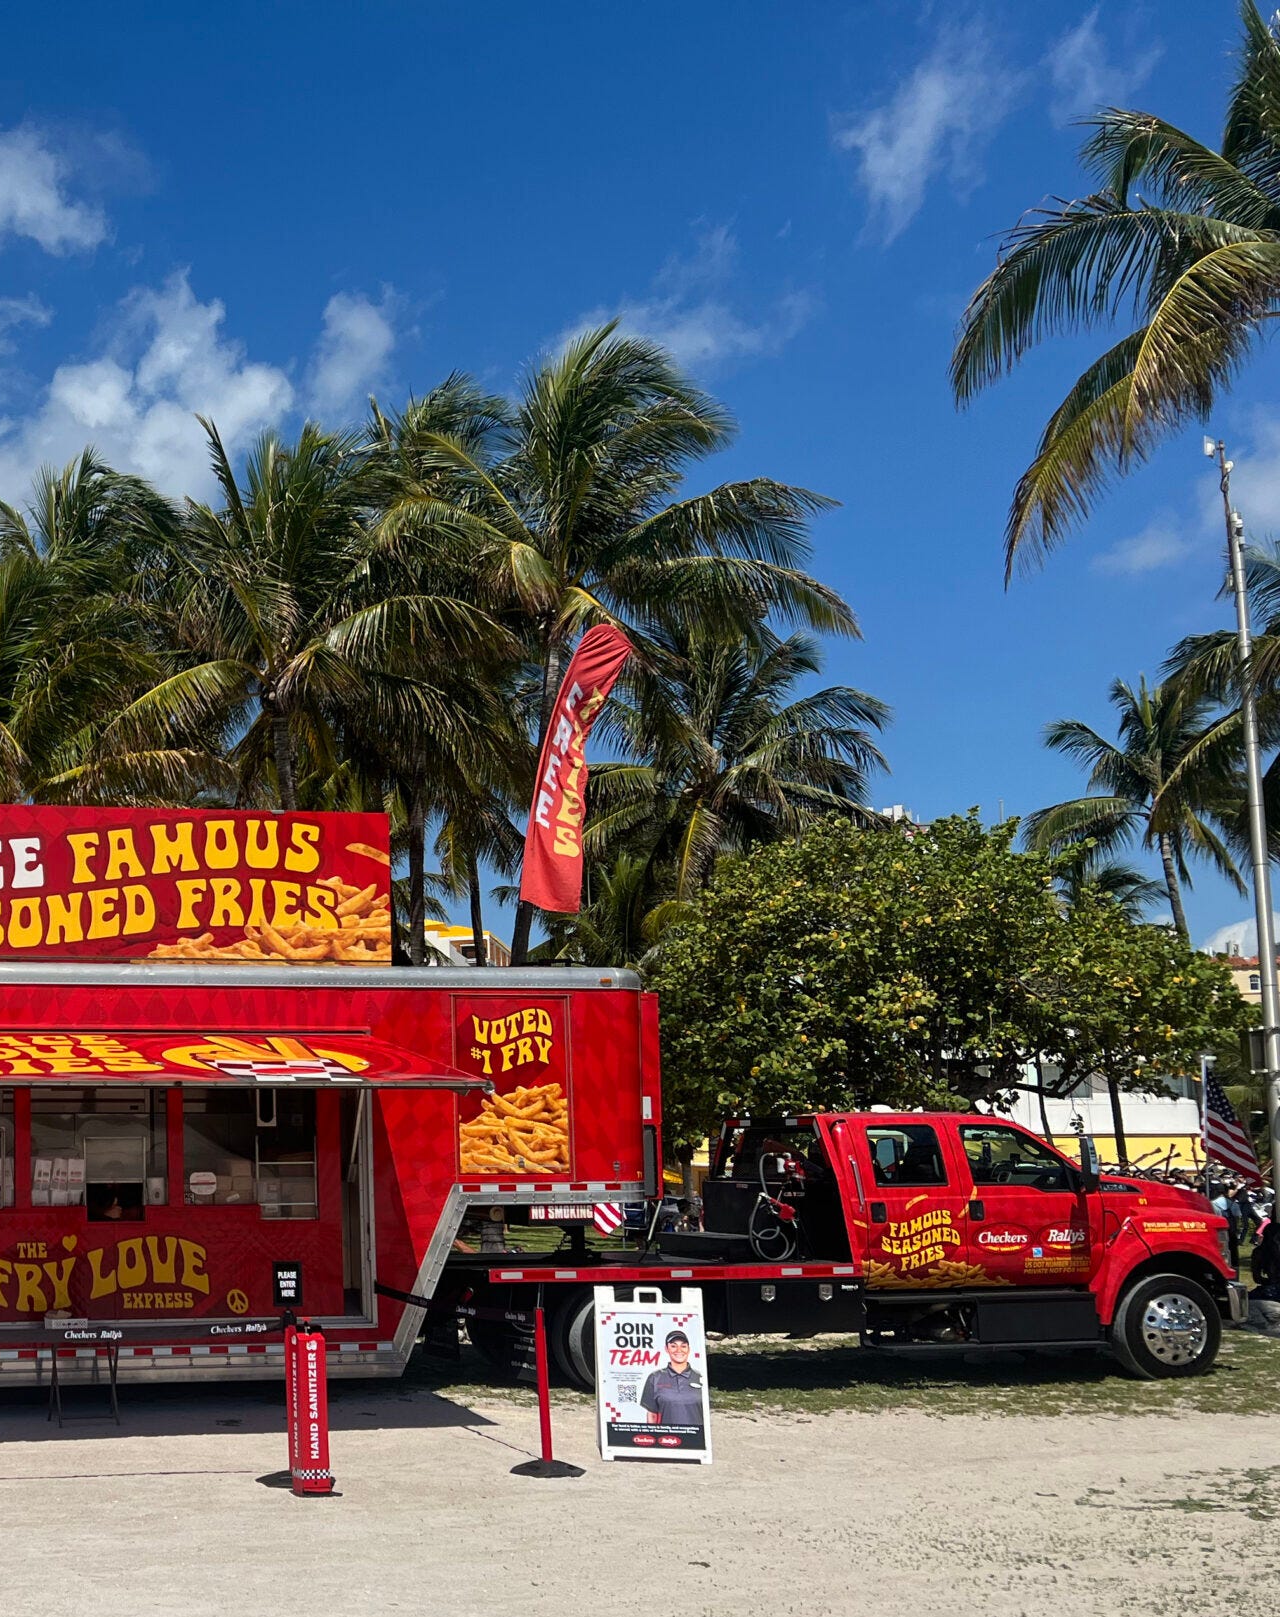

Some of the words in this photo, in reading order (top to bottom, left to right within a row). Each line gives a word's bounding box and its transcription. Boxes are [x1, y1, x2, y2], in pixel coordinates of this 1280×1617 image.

[536, 681, 582, 828] FREE
[66, 819, 320, 885] FAMOUS
[176, 878, 337, 929] FRIES
[472, 1008, 553, 1044] VOTED
[470, 1046, 493, 1074] #1
[500, 1036, 553, 1072] FRY
[531, 1205, 545, 1220] NO
[548, 1205, 594, 1220] SMOKING
[888, 1210, 952, 1238] FAMOUS
[882, 1227, 960, 1254] SEASONED
[978, 1231, 1028, 1244] Checkers
[1048, 1229, 1086, 1244] Rally's
[17, 1242, 48, 1258] THE
[901, 1244, 945, 1272] FRIES
[87, 1236, 210, 1300] LOVE
[278, 1271, 297, 1280] PLEASE
[280, 1280, 296, 1288] ENTER
[123, 1292, 194, 1309] EXPRESS
[281, 1290, 296, 1298] HERE
[64, 1330, 97, 1339] Checkers
[101, 1330, 122, 1340] Rally's
[210, 1324, 242, 1334] Checkers
[246, 1324, 267, 1334] Rally's
[614, 1322, 654, 1335] JOIN
[616, 1336, 654, 1349] OUR
[609, 1349, 661, 1366] TEAM
[308, 1352, 318, 1419] SANITIZER
[311, 1423, 319, 1460] HAND
